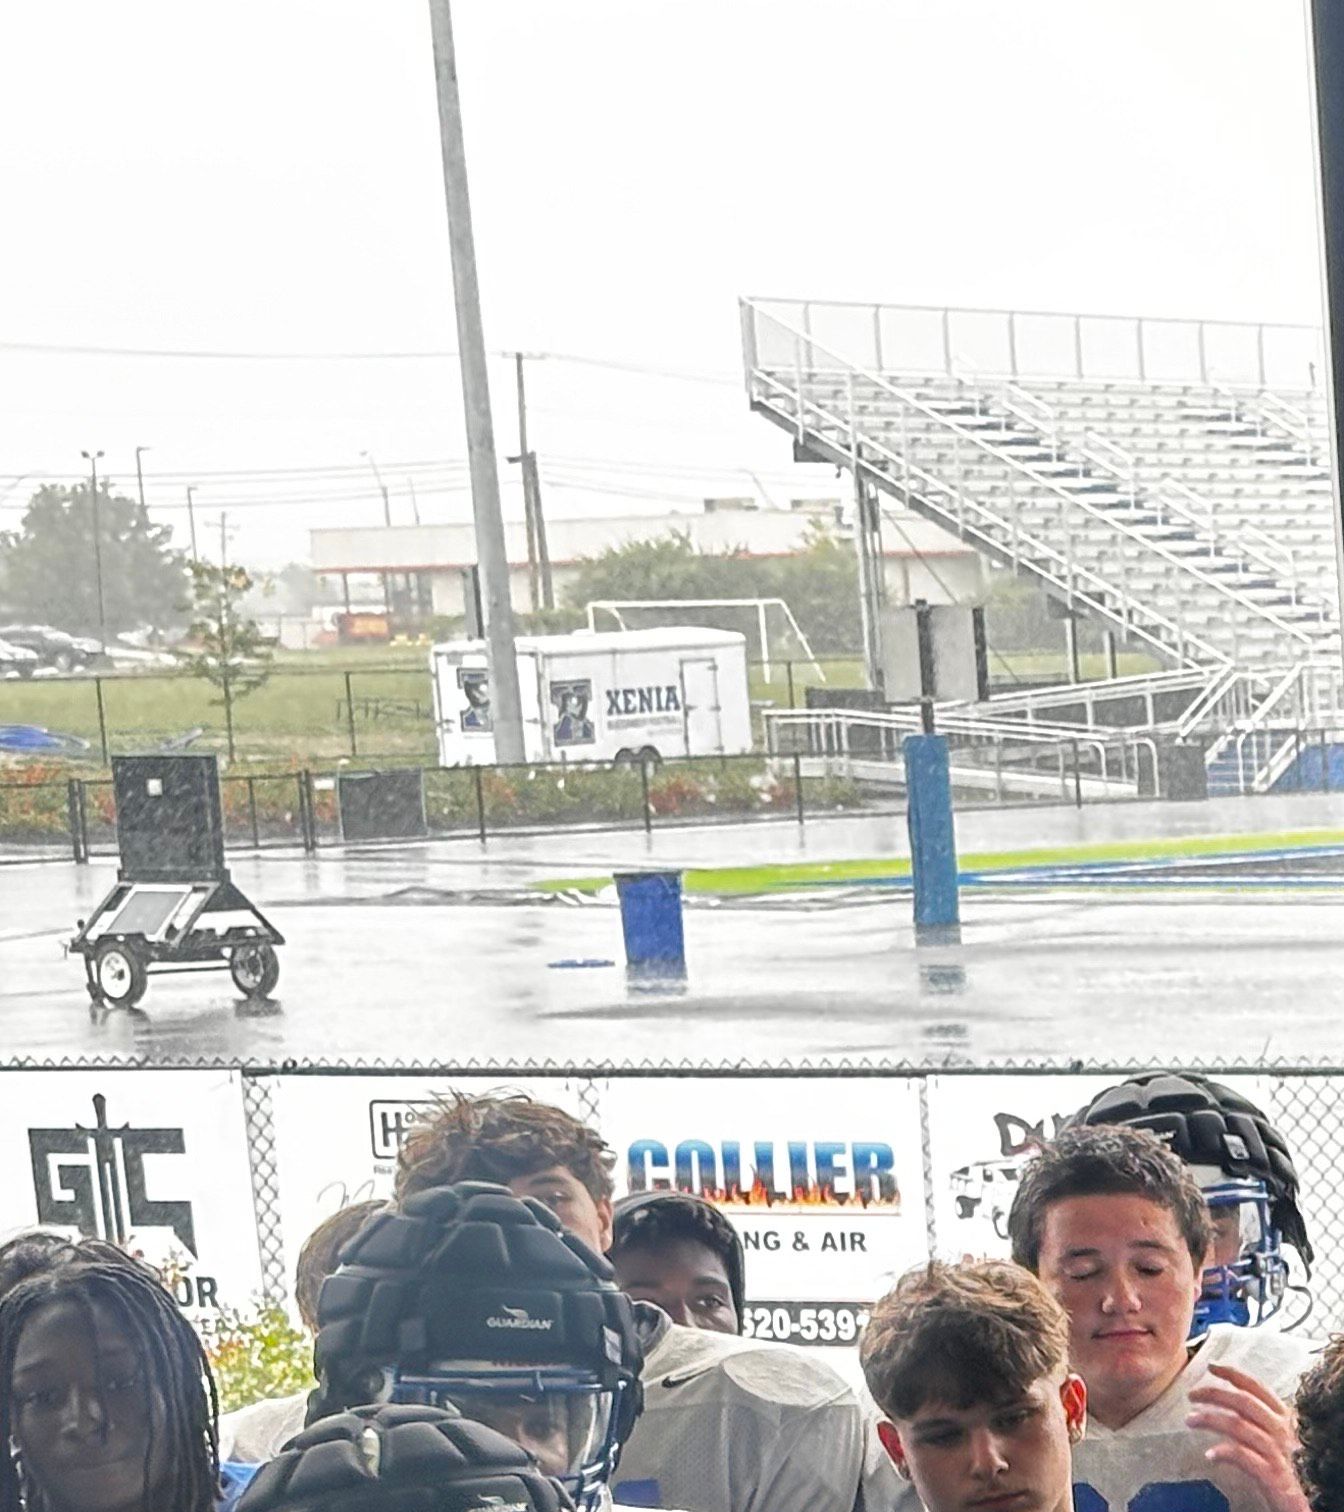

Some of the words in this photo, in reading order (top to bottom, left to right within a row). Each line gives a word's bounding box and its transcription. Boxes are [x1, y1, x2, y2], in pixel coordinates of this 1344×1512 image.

[606, 685, 681, 716] XENIA
[627, 1139, 901, 1207] COLLIER
[792, 1231, 810, 1251] &
[821, 1231, 867, 1252] AIR
